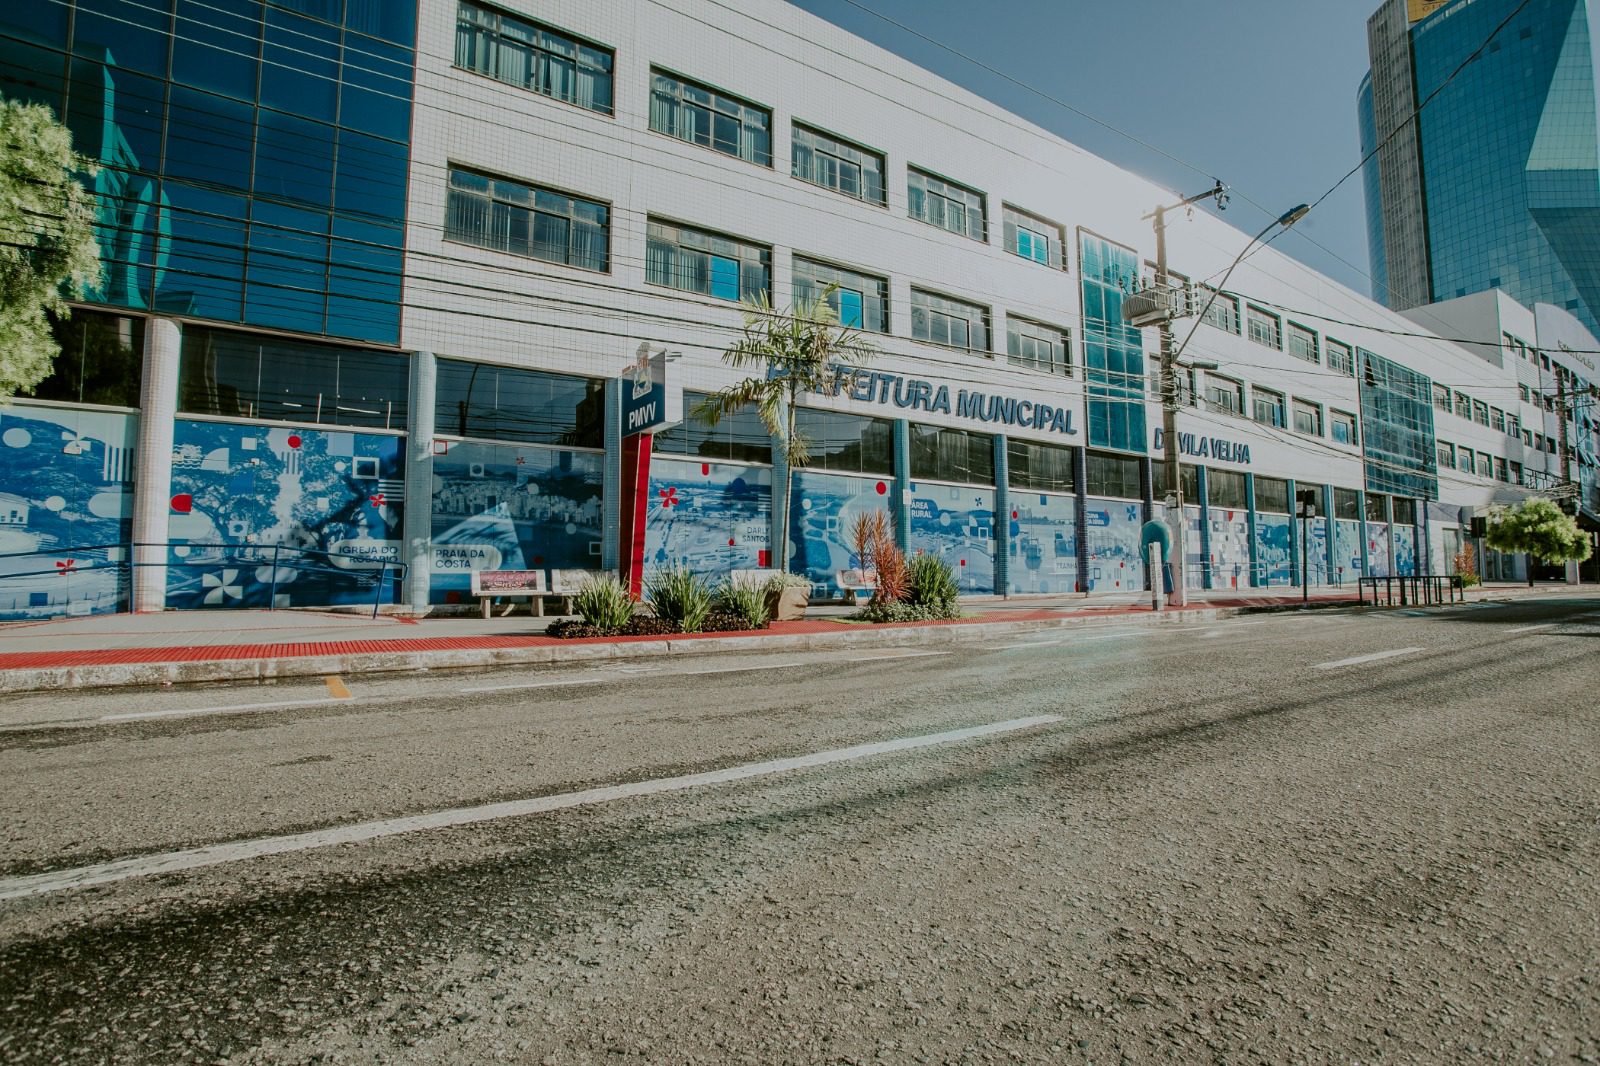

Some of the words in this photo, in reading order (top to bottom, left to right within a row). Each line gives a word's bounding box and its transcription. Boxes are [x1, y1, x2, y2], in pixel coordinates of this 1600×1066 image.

[763, 358, 951, 414] PFEITURA
[956, 389, 1077, 434] MUNICIPAL
[629, 401, 656, 430] PMVV
[1178, 432, 1209, 458] VILA
[1210, 438, 1251, 464] VELHA
[911, 510, 932, 519] RURAL
[747, 526, 770, 534] DARLY
[742, 535, 770, 543] SANTOS
[339, 546, 378, 554] IGREJA
[381, 546, 398, 554] DO
[436, 549, 467, 558] PRAIA
[470, 550, 485, 558] DA
[436, 560, 471, 568] COSTA
